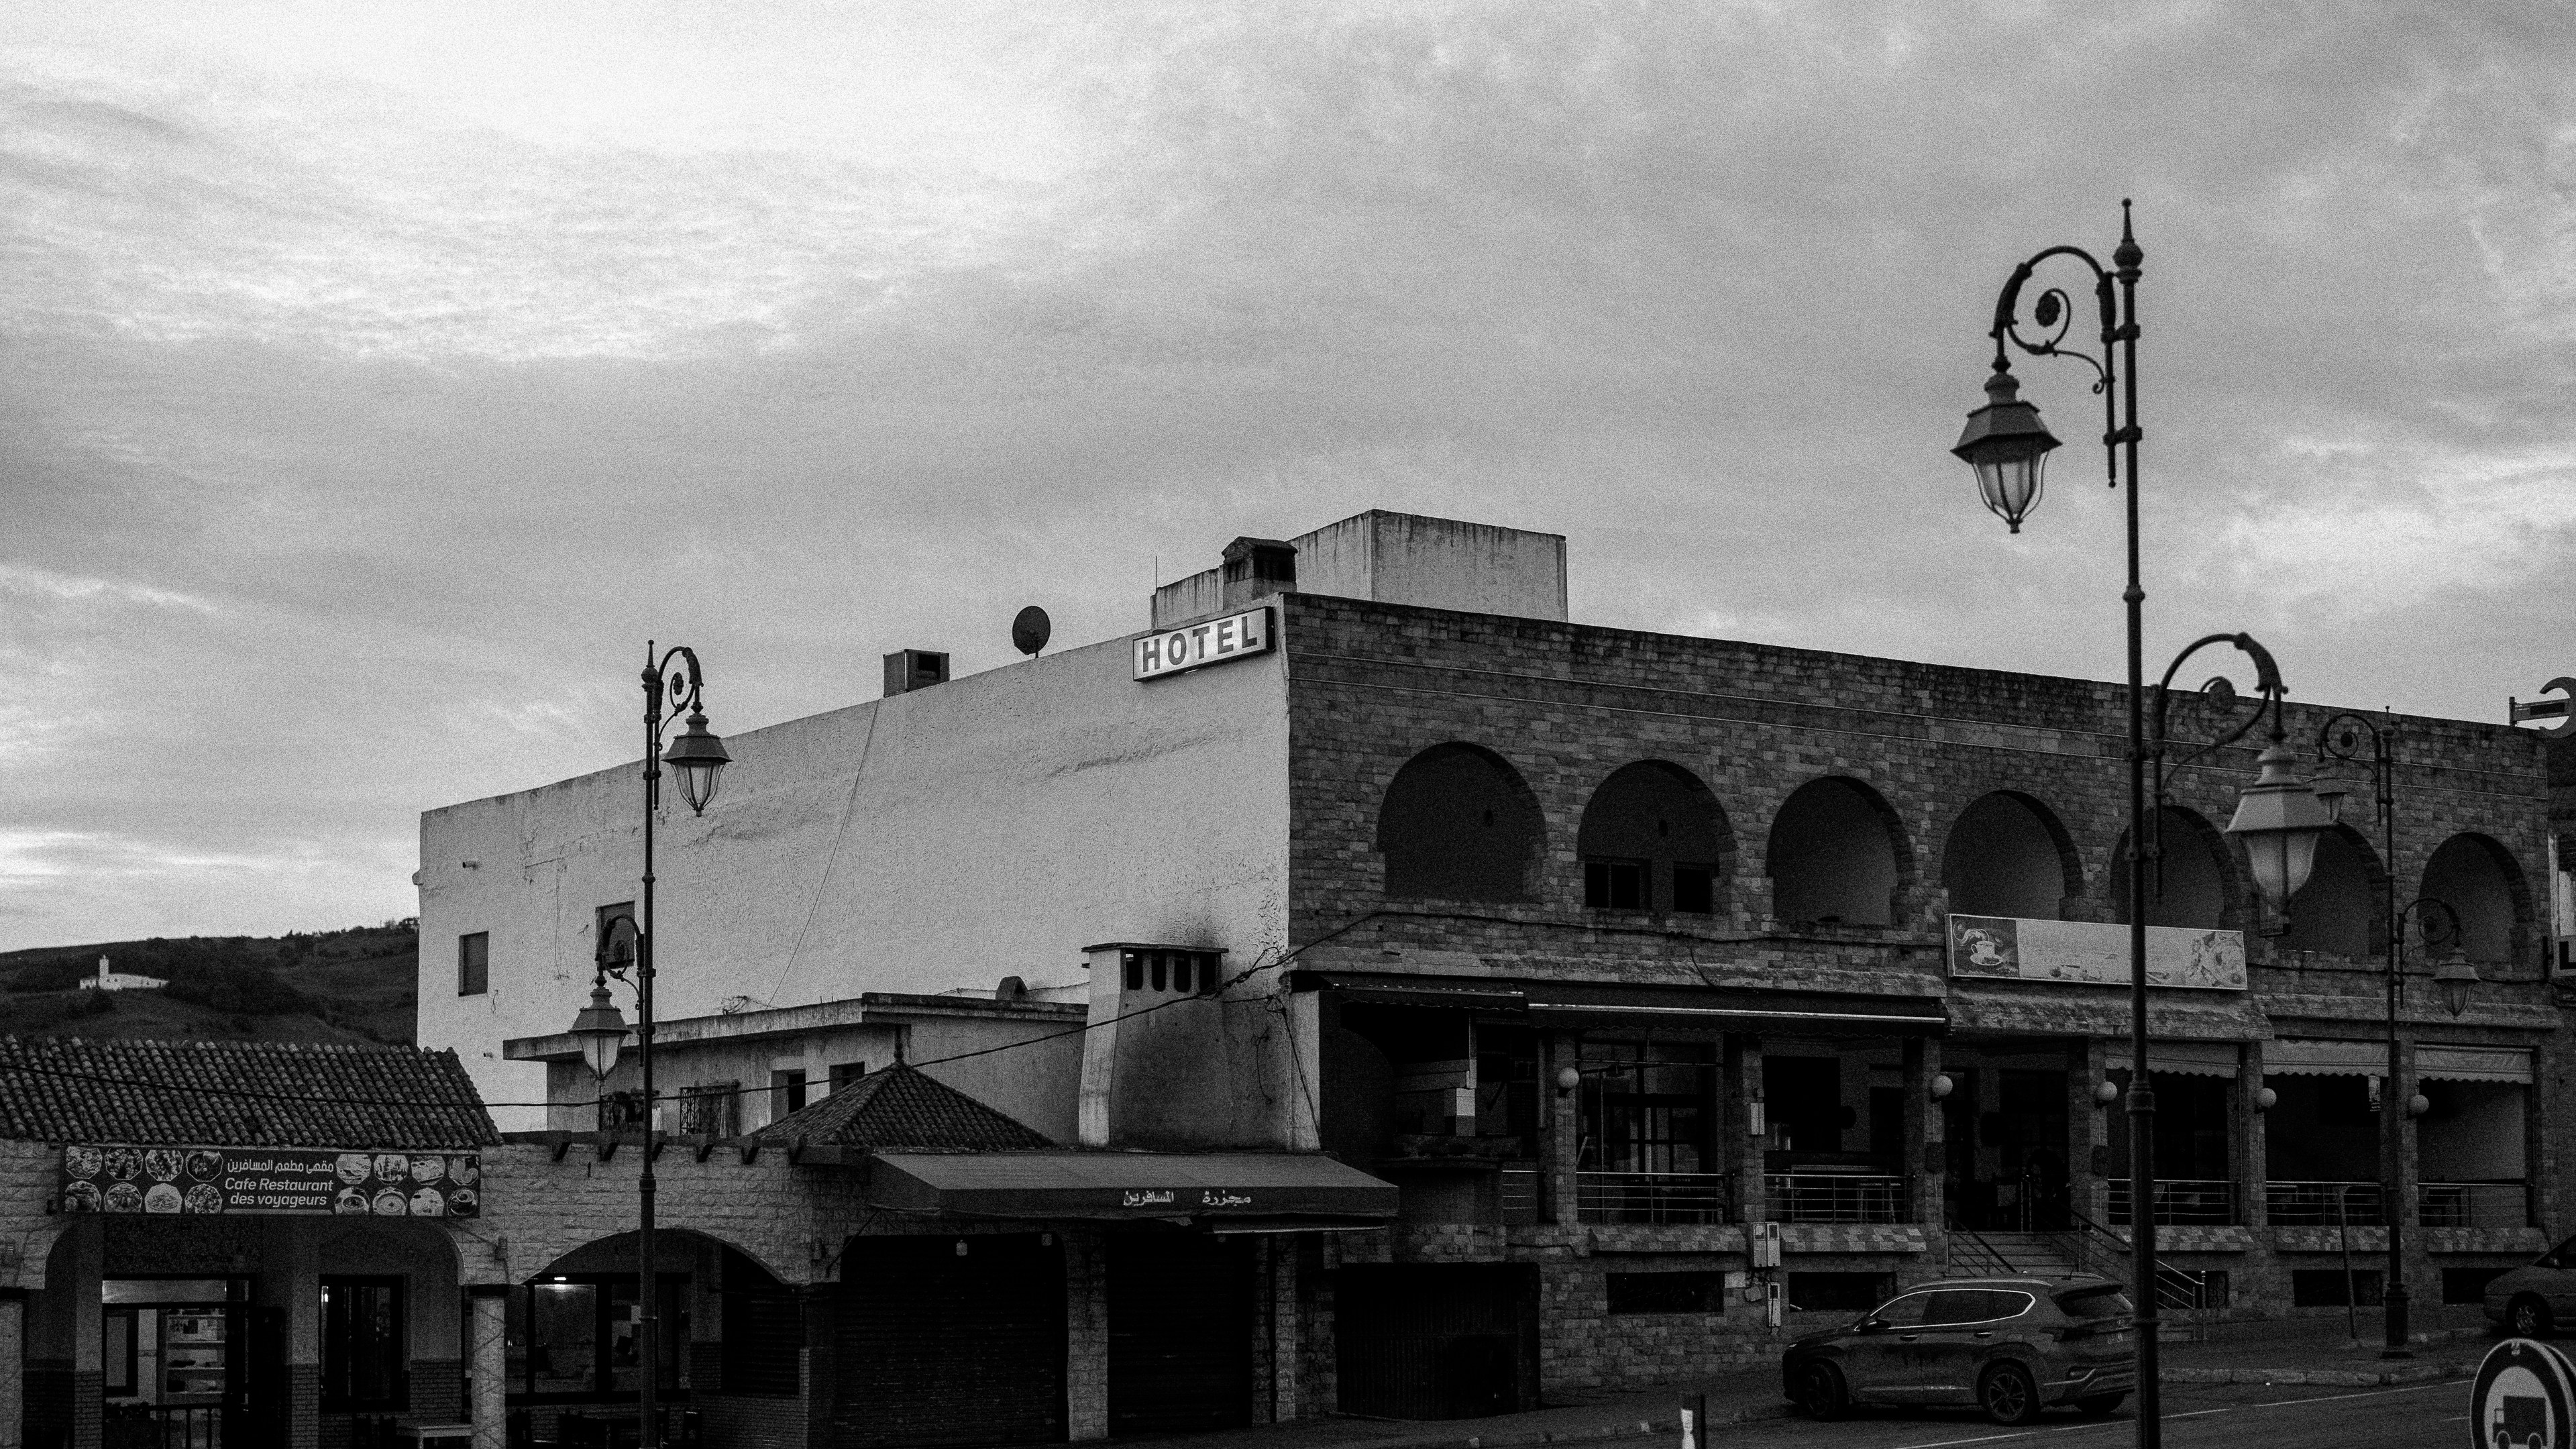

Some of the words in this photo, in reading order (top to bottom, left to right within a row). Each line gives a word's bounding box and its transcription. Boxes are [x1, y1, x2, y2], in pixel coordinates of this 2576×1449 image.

[1142, 616, 1258, 673] HOTEL
[227, 1159, 273, 1173] المسافرين
[274, 1159, 304, 1174] مطعم
[306, 1160, 334, 1175] مقهى
[225, 1177, 257, 1191] Cafe
[259, 1177, 334, 1191] Restaurant
[230, 1191, 255, 1205] des
[258, 1195, 327, 1208] voyageurs
[1123, 1190, 1174, 1206] المسافرين
[1202, 1189, 1252, 1207] مجزرة
